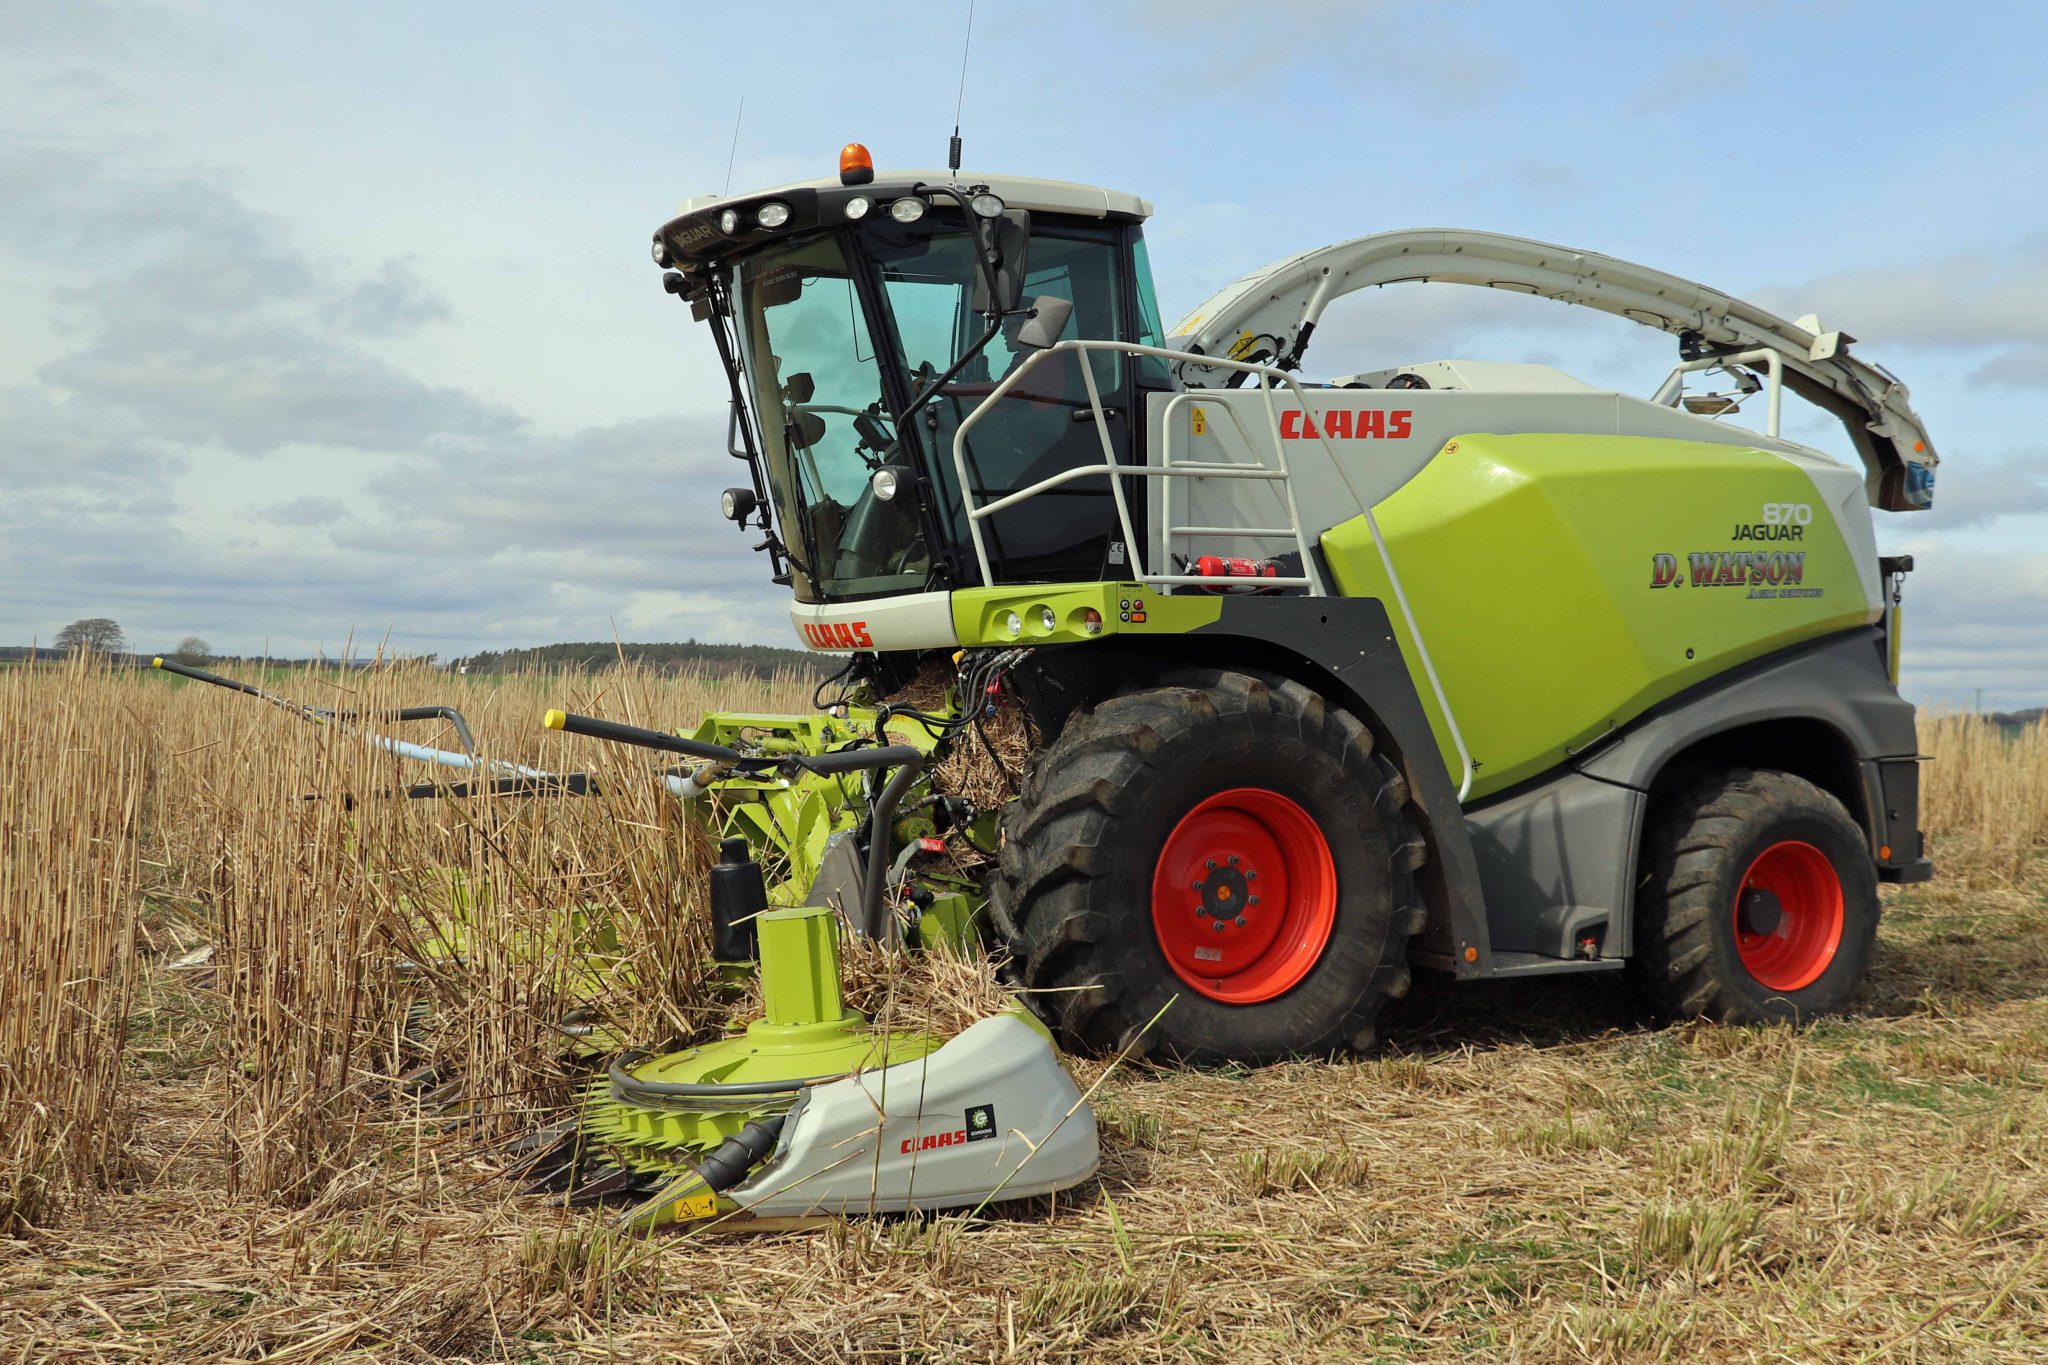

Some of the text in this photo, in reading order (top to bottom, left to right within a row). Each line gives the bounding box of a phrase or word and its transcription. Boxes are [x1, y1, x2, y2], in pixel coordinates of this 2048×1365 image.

[1280, 410, 1412, 439] CLAAS
[1762, 502, 1812, 525] 870
[1731, 524, 1803, 541] JAGUAR
[1650, 550, 1807, 588] D. WATSON
[804, 621, 874, 649] CLAAS
[900, 1129, 966, 1154] CLAAS
